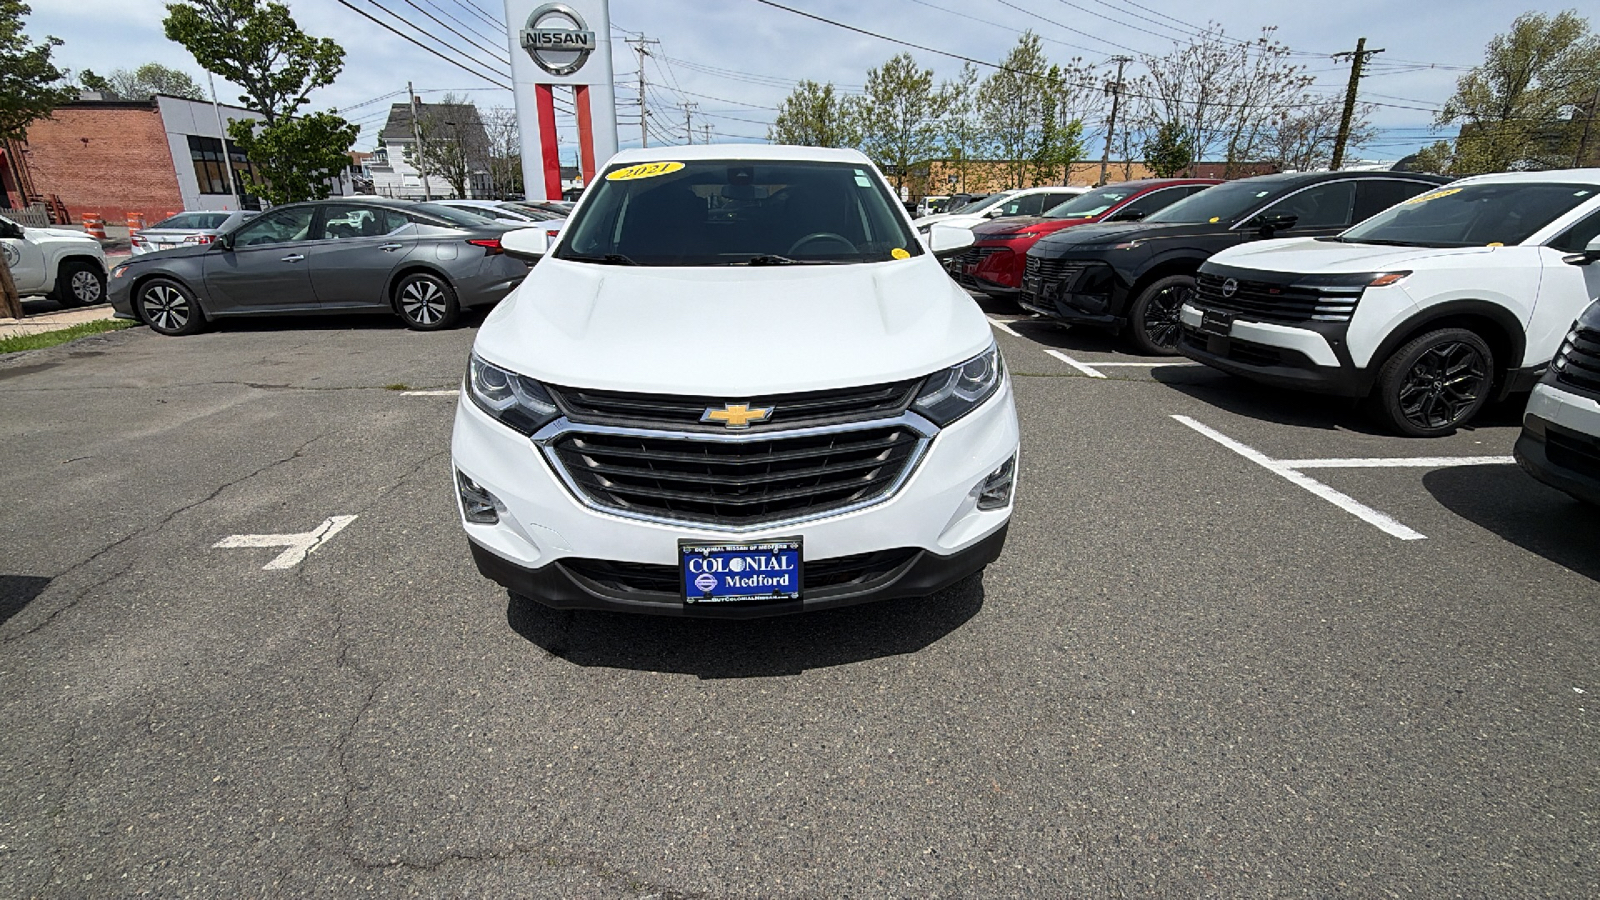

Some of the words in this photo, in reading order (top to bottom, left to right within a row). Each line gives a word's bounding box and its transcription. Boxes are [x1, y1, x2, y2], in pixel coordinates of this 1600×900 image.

[526, 32, 588, 45] NISSAN
[620, 163, 670, 178] 2021
[689, 556, 794, 573] COLONIAL
[725, 574, 789, 587] Medford
